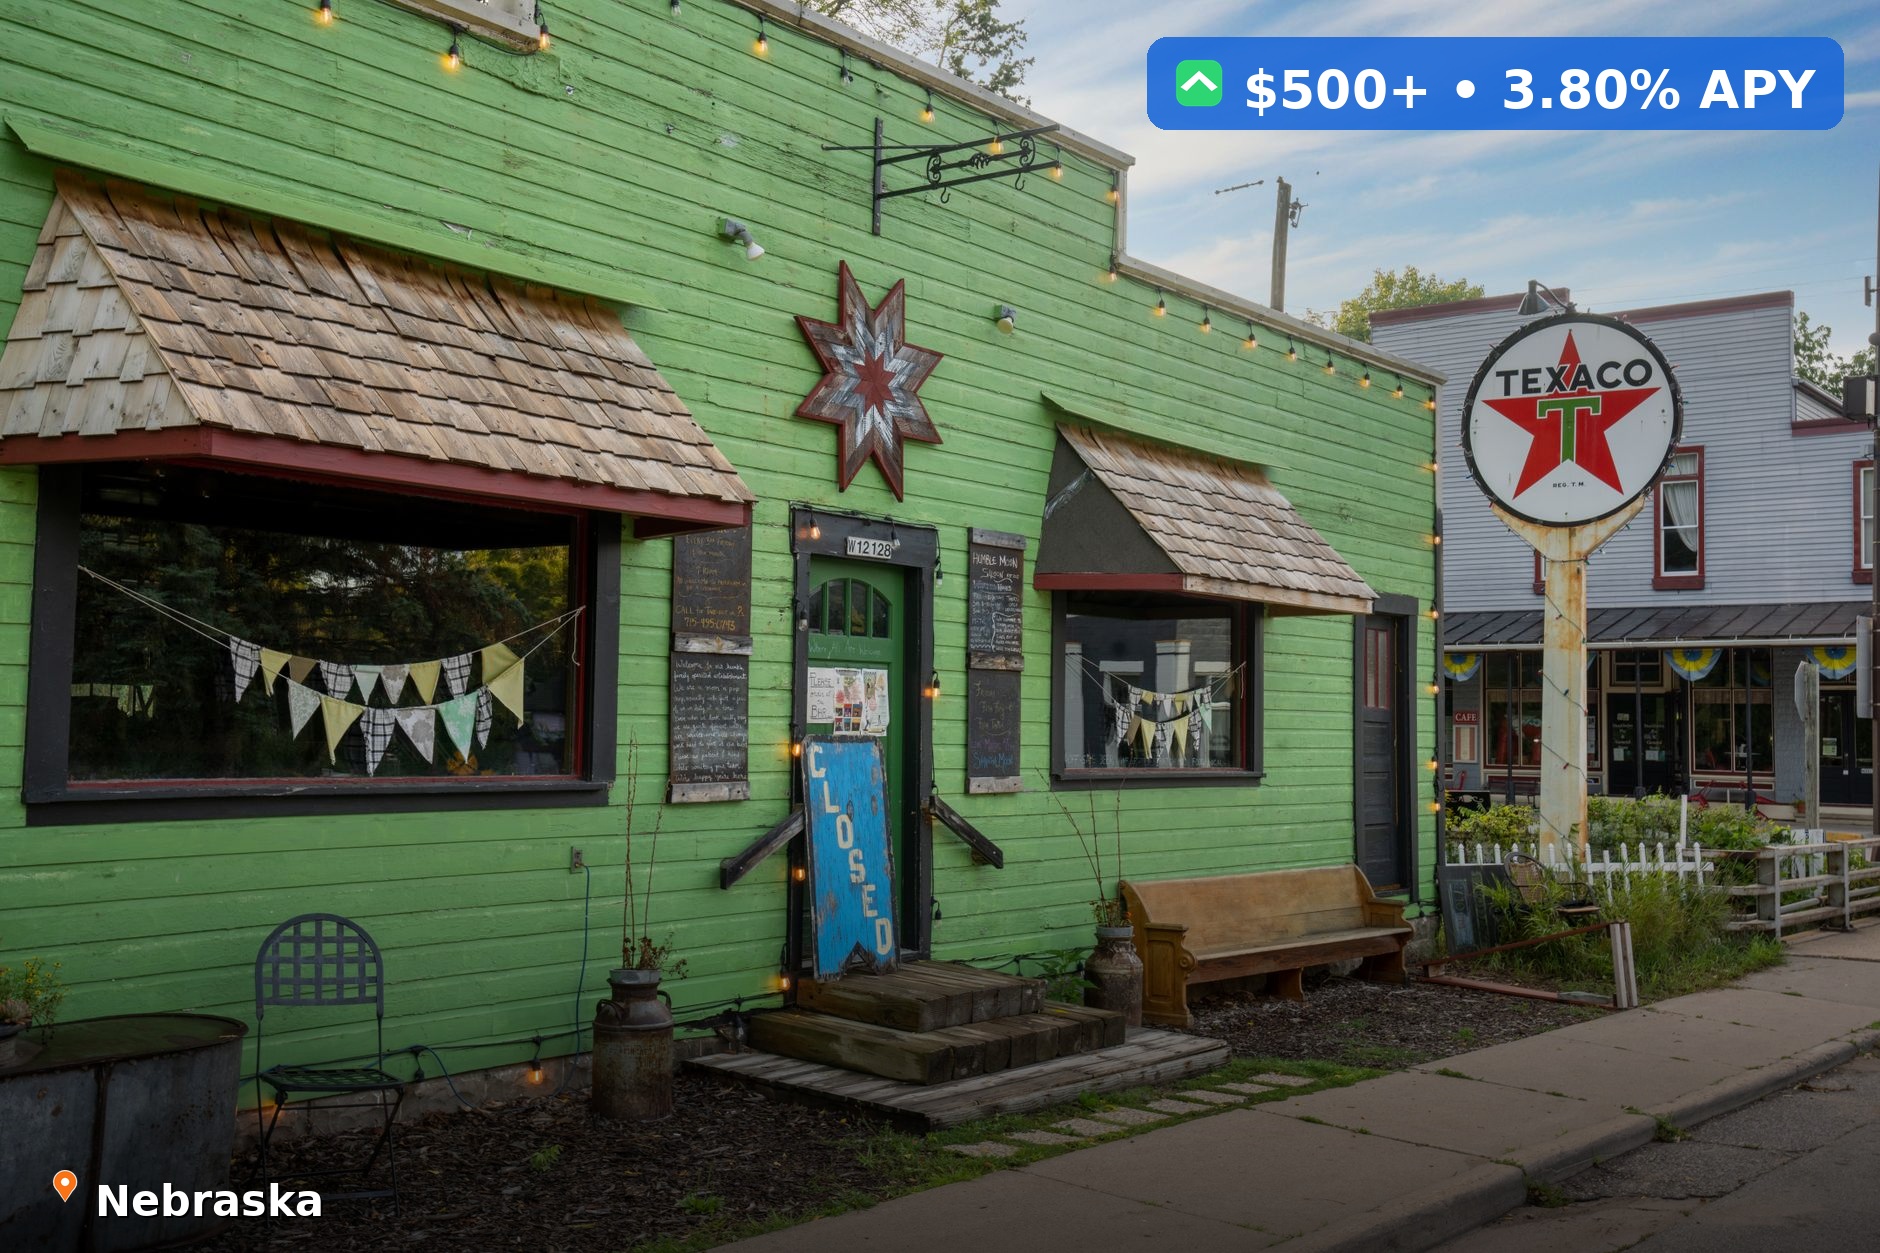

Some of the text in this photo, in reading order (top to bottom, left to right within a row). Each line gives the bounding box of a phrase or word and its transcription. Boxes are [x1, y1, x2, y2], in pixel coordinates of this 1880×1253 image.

[1495, 358, 1653, 397] TEXACO
[1537, 395, 1602, 464] T
[972, 551, 998, 566] HUMBLE
[1455, 712, 1477, 722] CAFE
[809, 744, 893, 956] CLOSED
